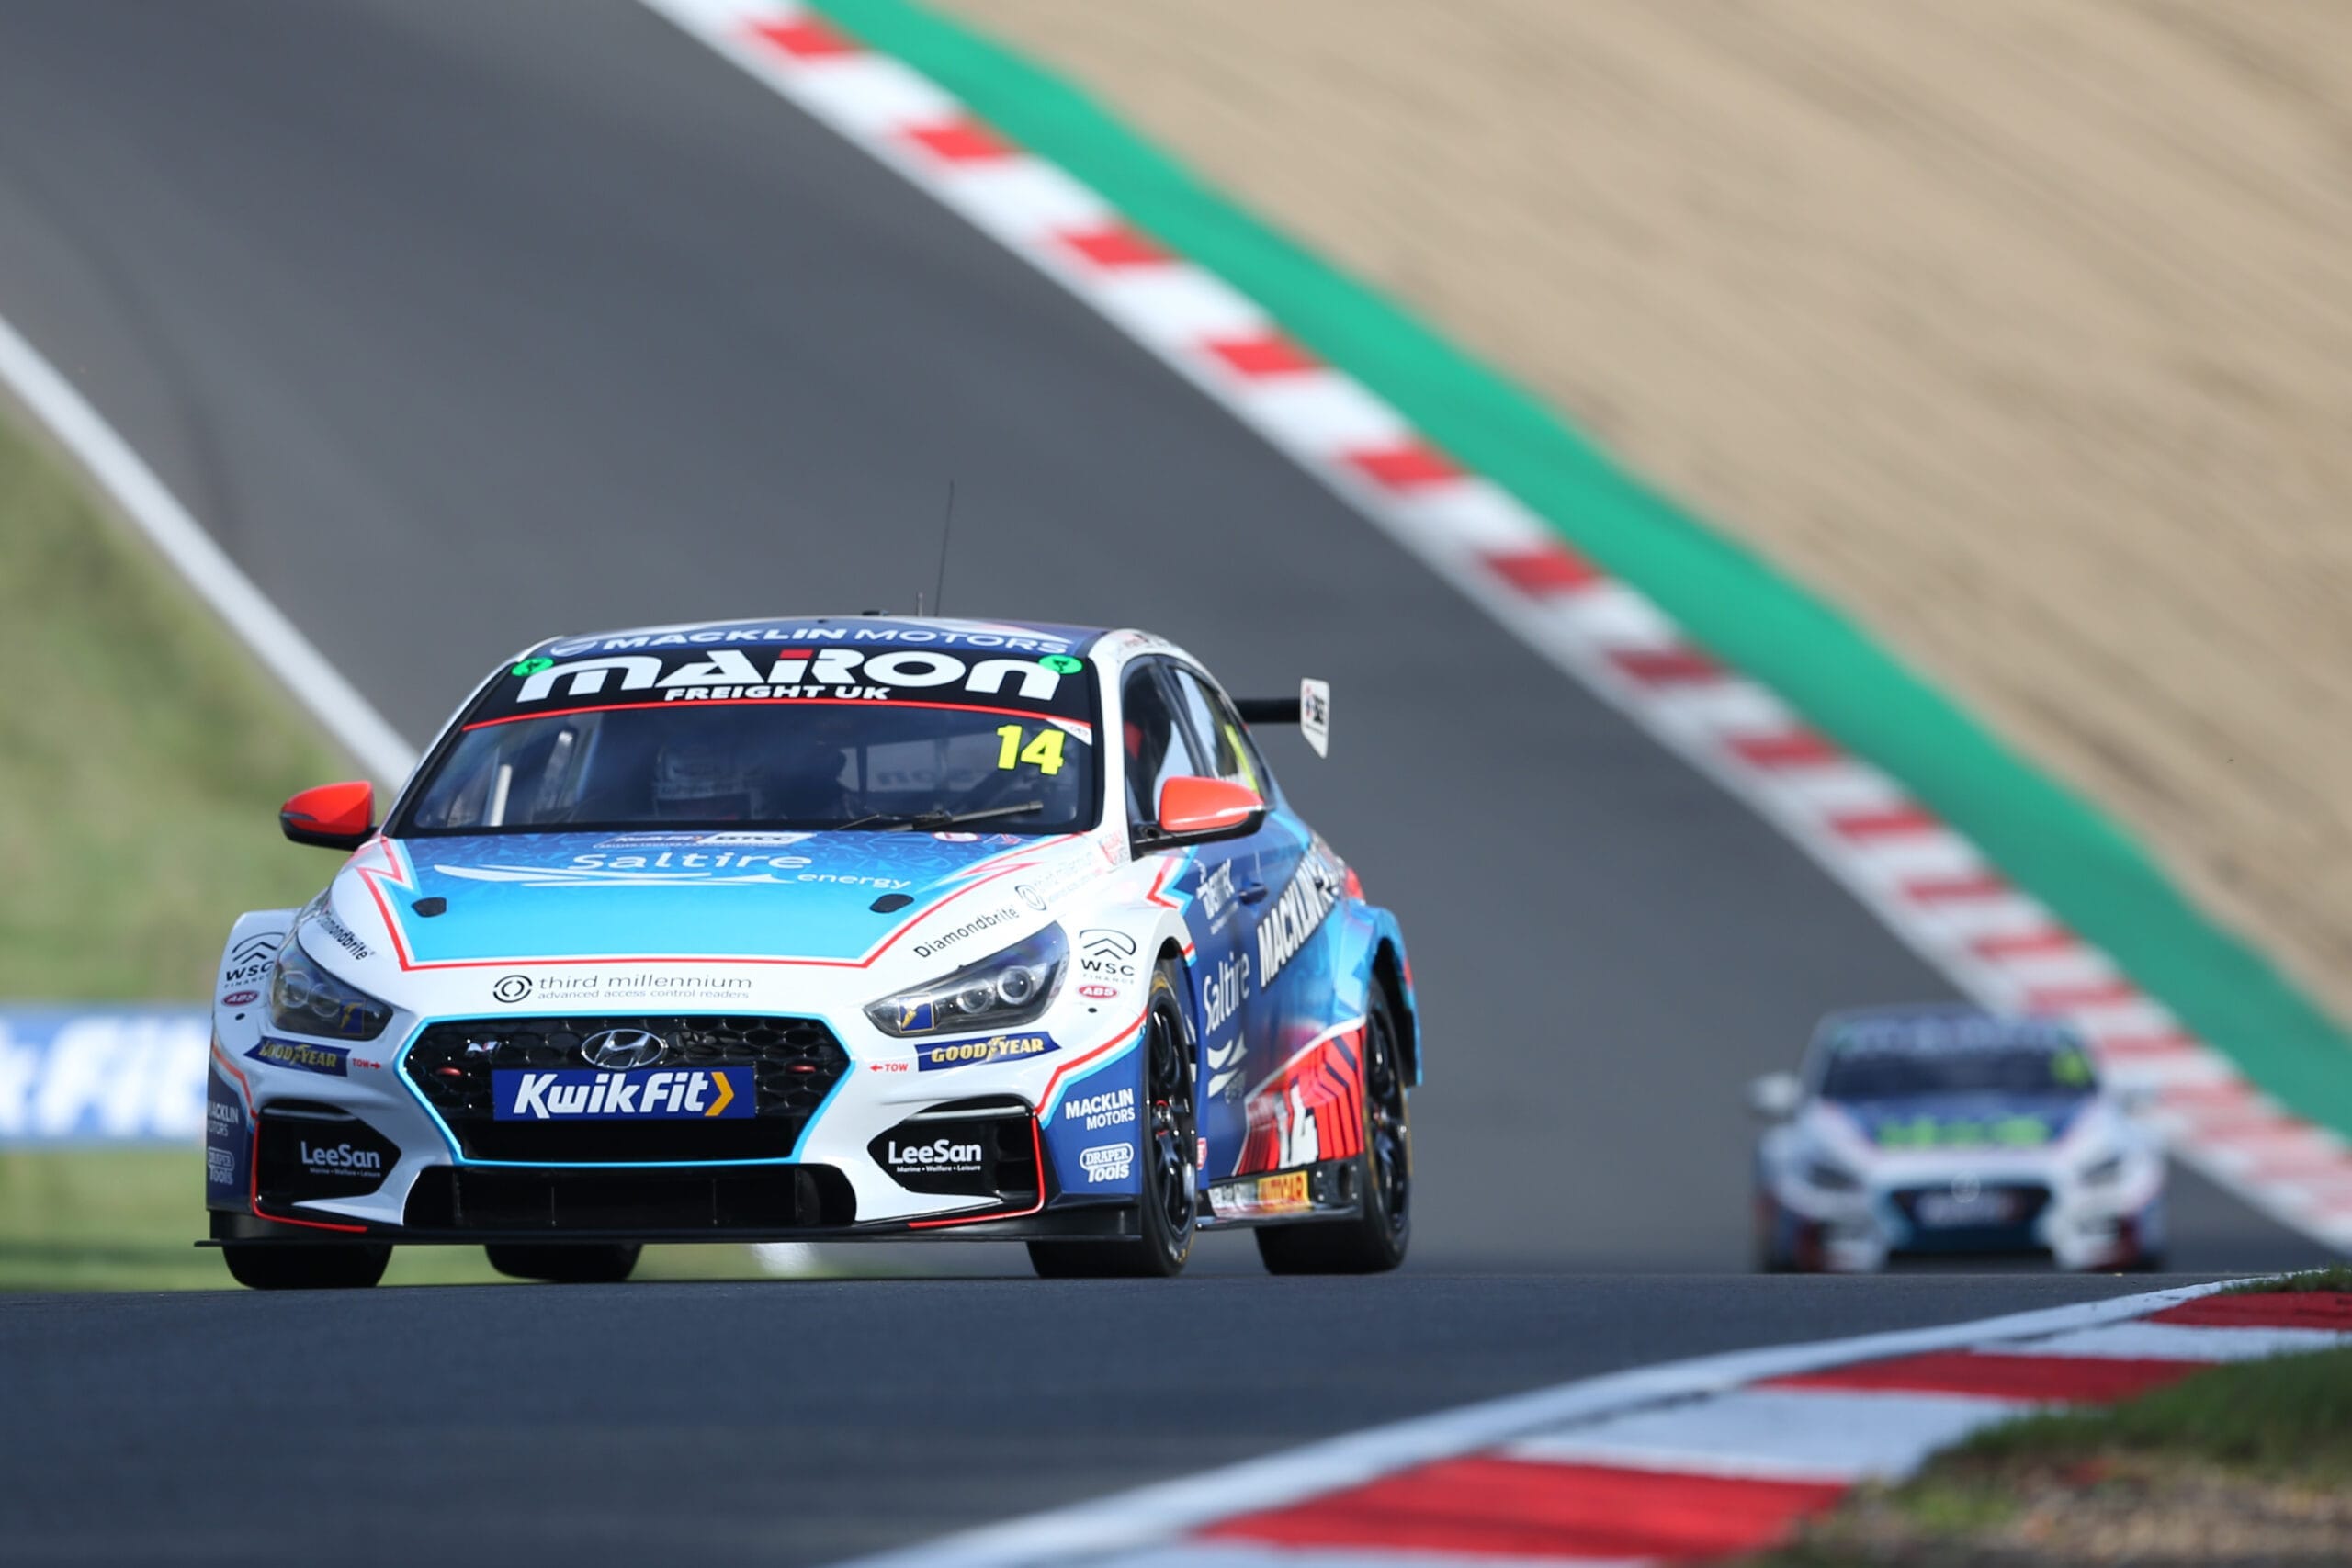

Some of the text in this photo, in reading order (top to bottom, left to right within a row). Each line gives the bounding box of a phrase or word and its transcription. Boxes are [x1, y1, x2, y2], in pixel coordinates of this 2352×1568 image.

[602, 628, 1068, 654] MACKLIN MOTORS
[663, 685, 891, 701] FREIGHT UK
[996, 724, 1066, 775] 14
[567, 851, 812, 870] Saltire
[797, 873, 912, 889] energy
[913, 907, 1019, 959] Diamondbrite
[1080, 958, 1136, 976] WSC
[539, 973, 752, 989] third millennium
[538, 989, 750, 999] advanced access control readers
[931, 1035, 1045, 1063] GOODYEAR
[353, 1058, 370, 1068] TOW
[885, 1063, 909, 1072] TOW
[1065, 1088, 1135, 1120] MACKLIN
[1086, 1107, 1136, 1130] MOTORS
[300, 1140, 381, 1168] LeeSan
[888, 1139, 982, 1164] LeeSan
[1085, 1147, 1129, 1165] DRAPER
